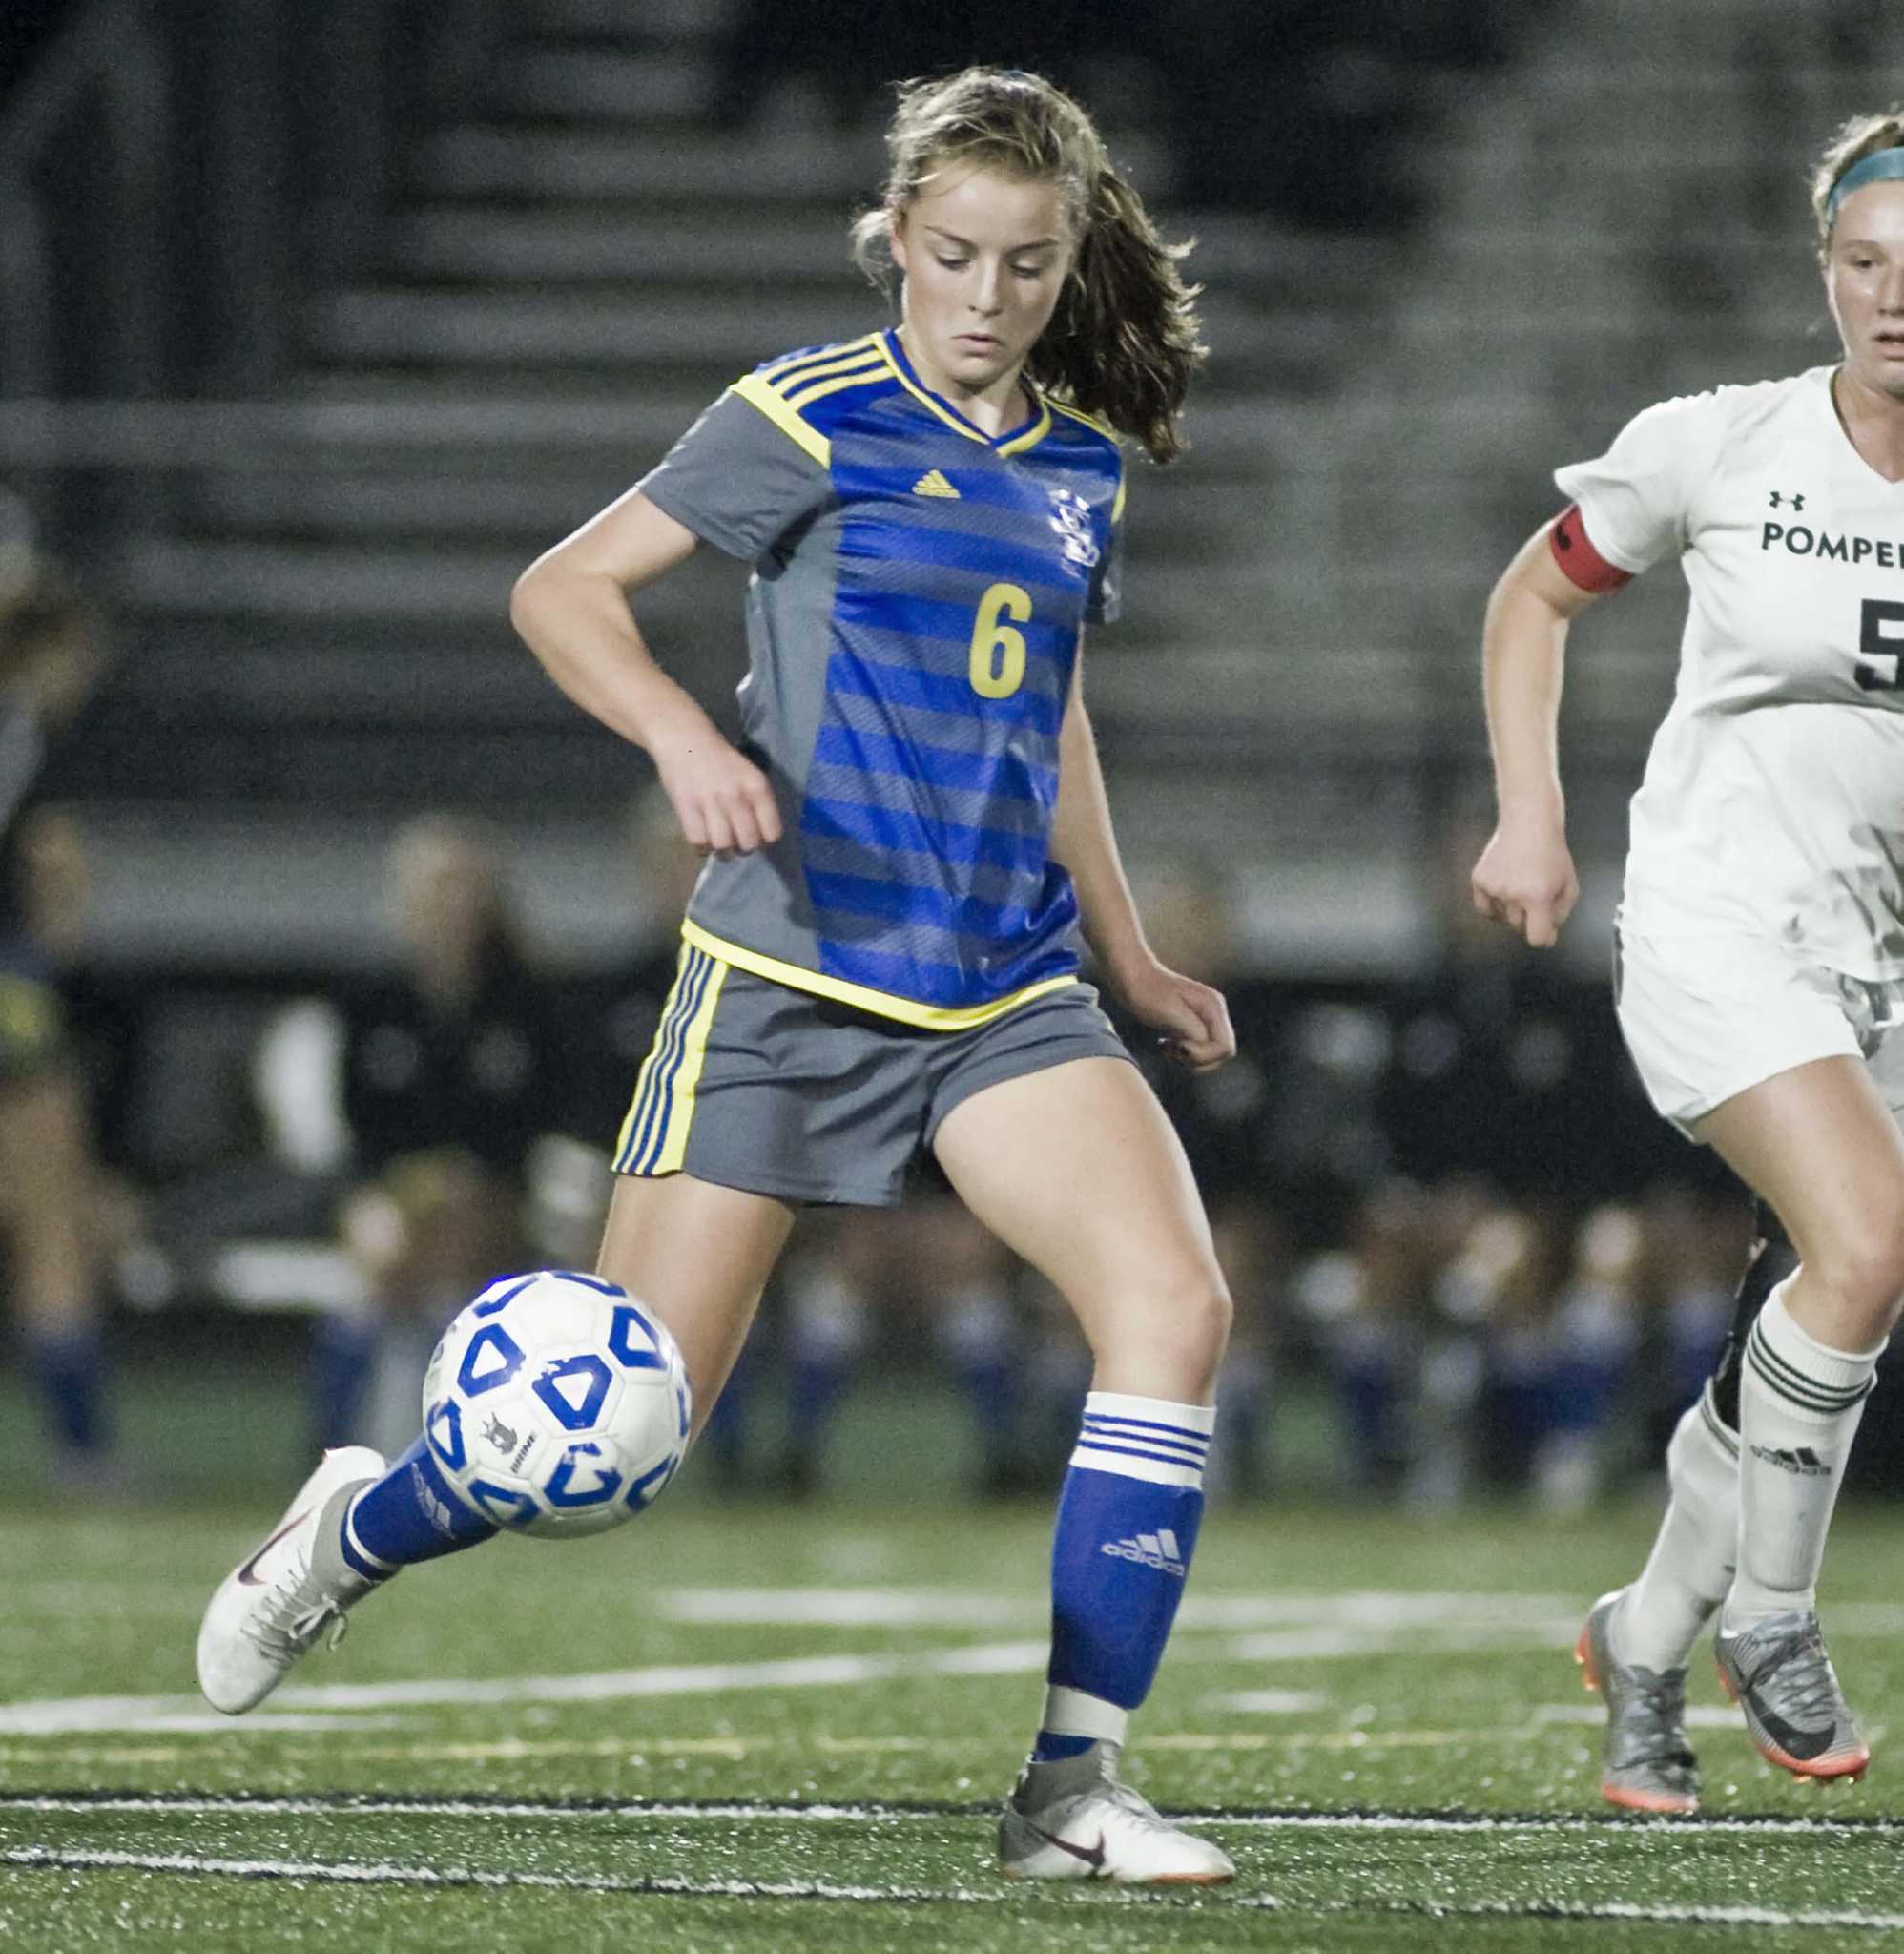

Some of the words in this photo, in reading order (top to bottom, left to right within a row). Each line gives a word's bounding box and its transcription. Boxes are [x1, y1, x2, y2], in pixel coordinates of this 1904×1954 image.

[1762, 521, 1904, 570] POMPE
[969, 583, 1032, 699] 6
[1854, 598, 1904, 691] 5
